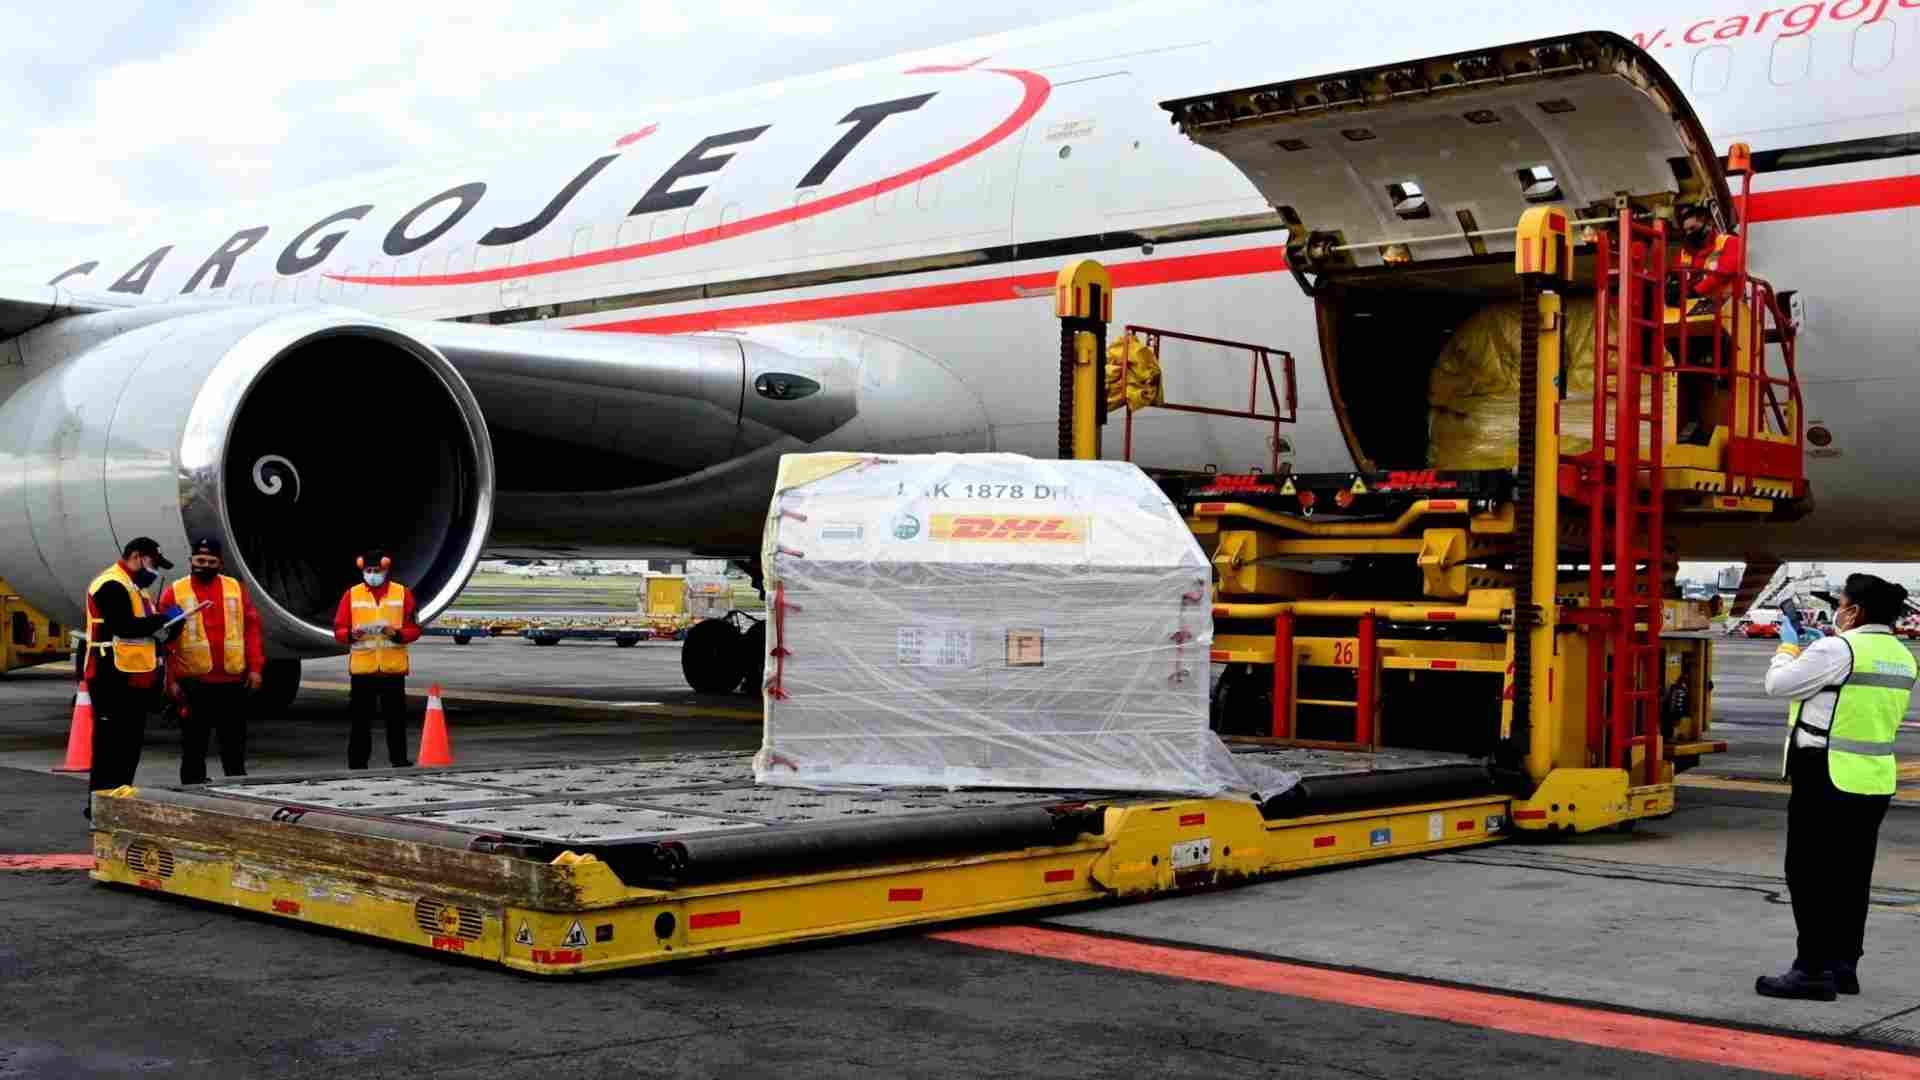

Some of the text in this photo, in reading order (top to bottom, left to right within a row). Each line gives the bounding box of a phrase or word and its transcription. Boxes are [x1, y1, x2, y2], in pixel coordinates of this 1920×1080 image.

[964, 484, 1024, 499] 1878
[951, 517, 1073, 539] DHL
[1334, 641, 1353, 664] 26
